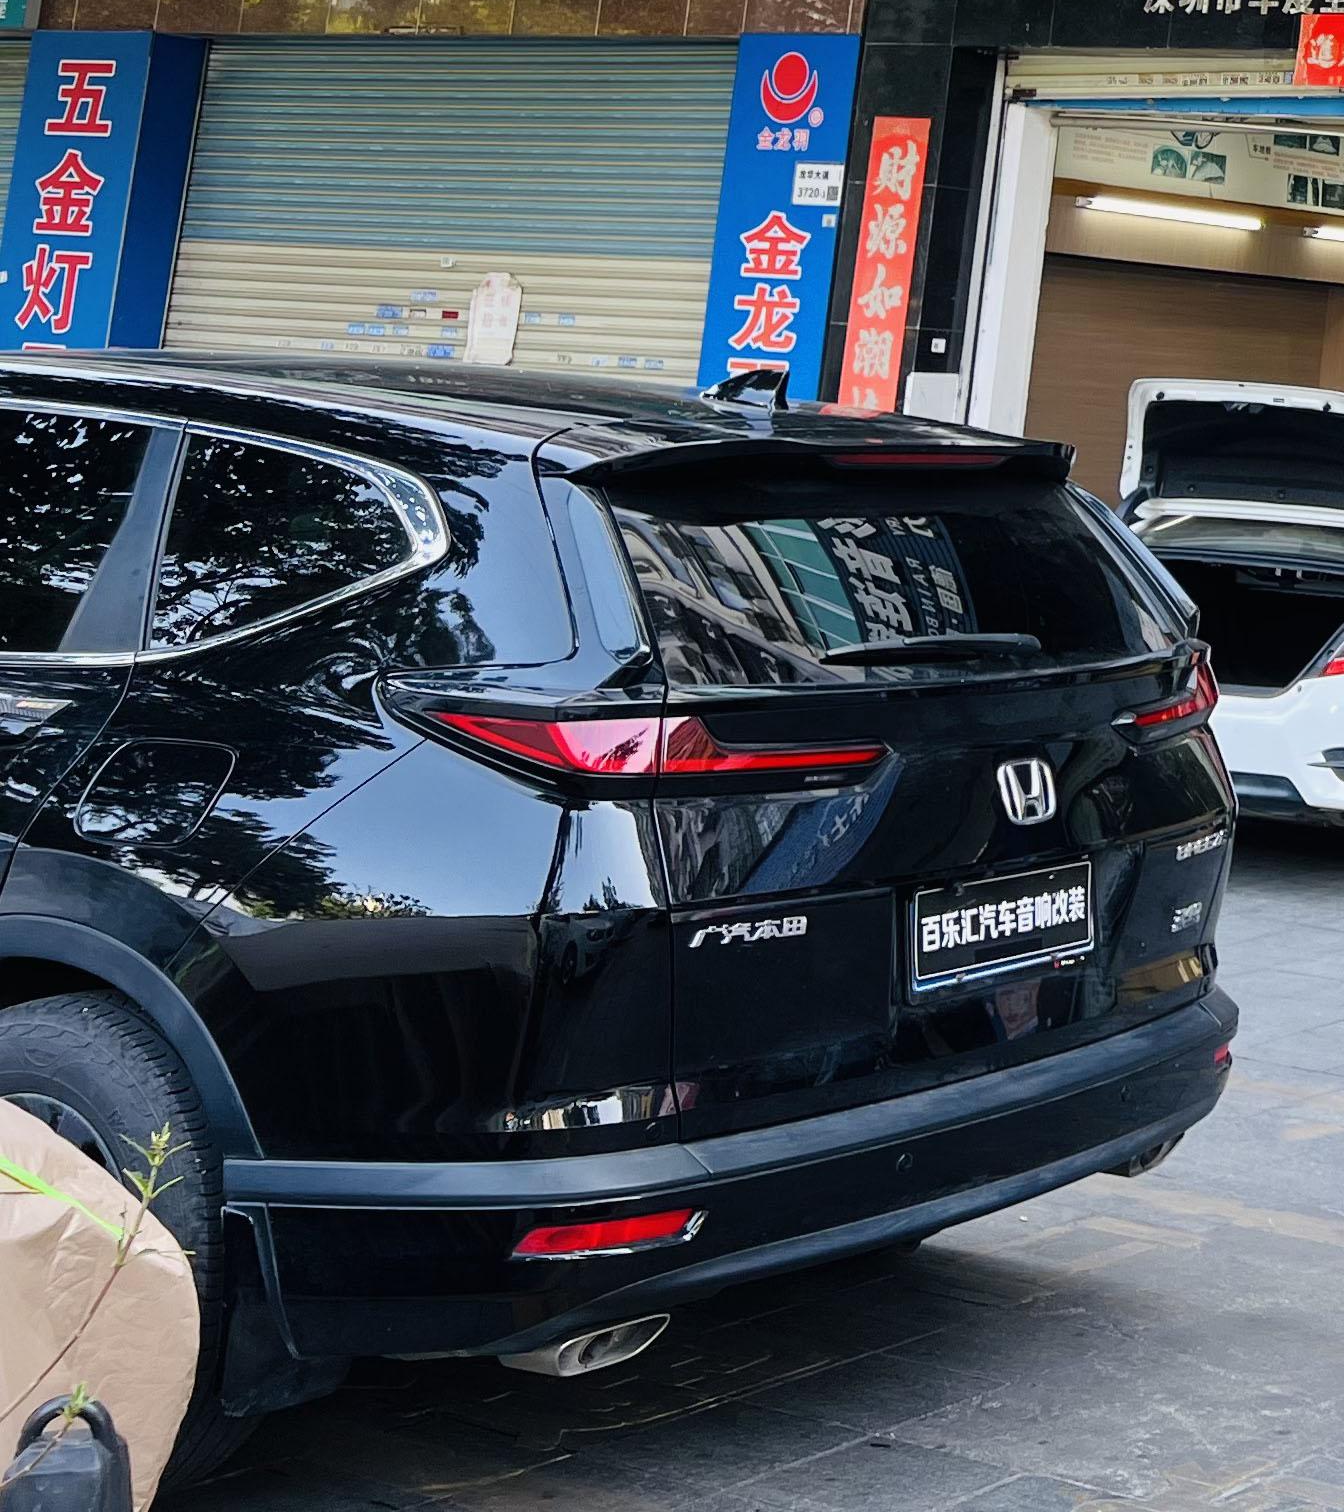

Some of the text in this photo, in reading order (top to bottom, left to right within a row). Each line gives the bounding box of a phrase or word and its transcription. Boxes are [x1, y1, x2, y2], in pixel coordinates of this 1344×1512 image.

[756, 126, 810, 152] 金龙羽
[14, 59, 117, 350] 五金灯
[728, 210, 812, 379] 金龙
[688, 915, 808, 949] 广汽本田
[920, 885, 1087, 953] 百乐汇汽车音响改装
